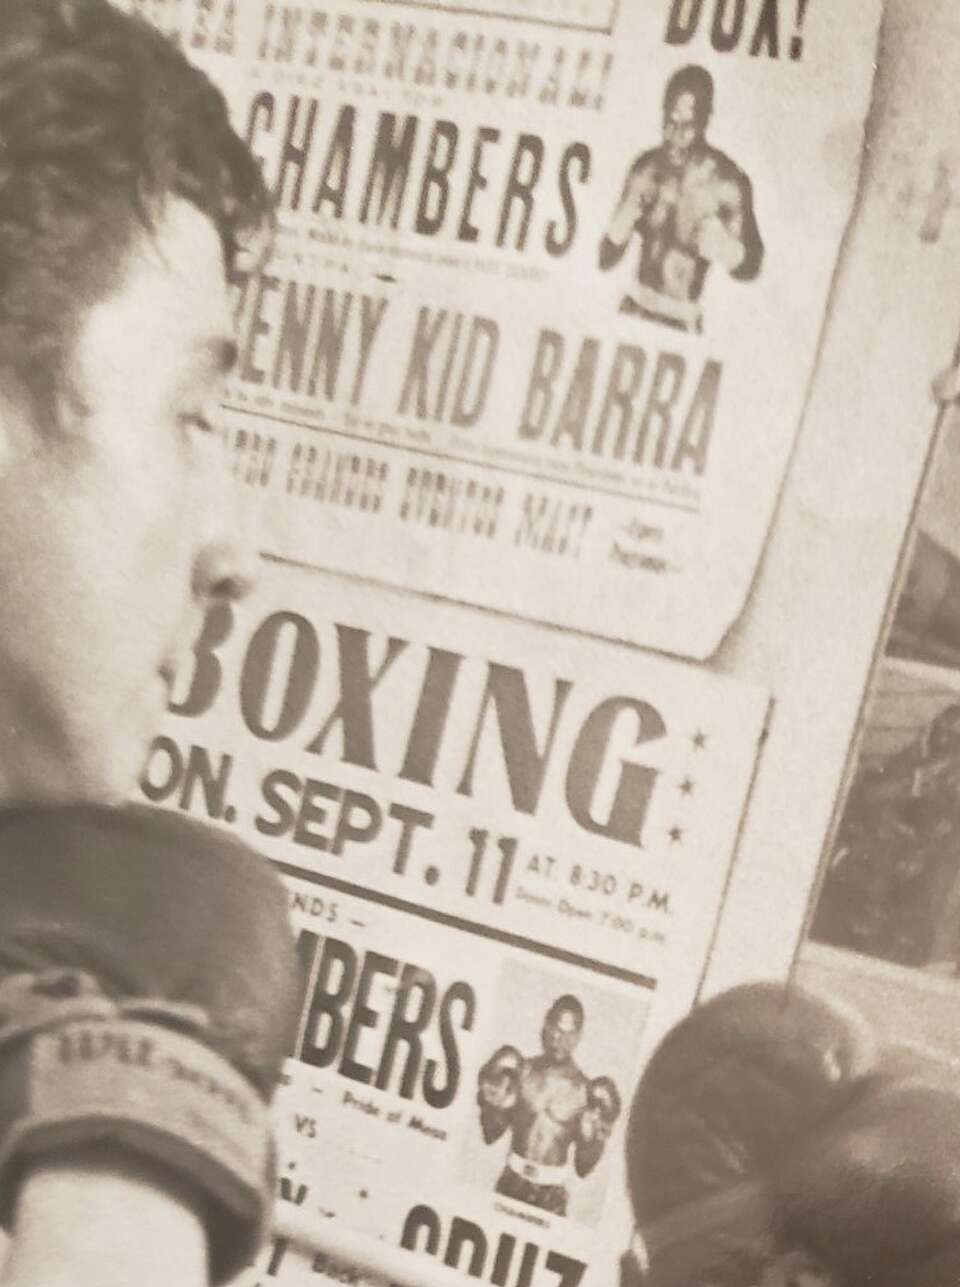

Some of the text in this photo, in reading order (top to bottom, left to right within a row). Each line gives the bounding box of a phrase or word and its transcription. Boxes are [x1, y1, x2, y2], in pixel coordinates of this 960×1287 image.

[398, 304, 501, 430] KID
[517, 327, 724, 478] BARRA
[253, 769, 441, 888] SEPT.
[464, 828, 519, 905] 11
